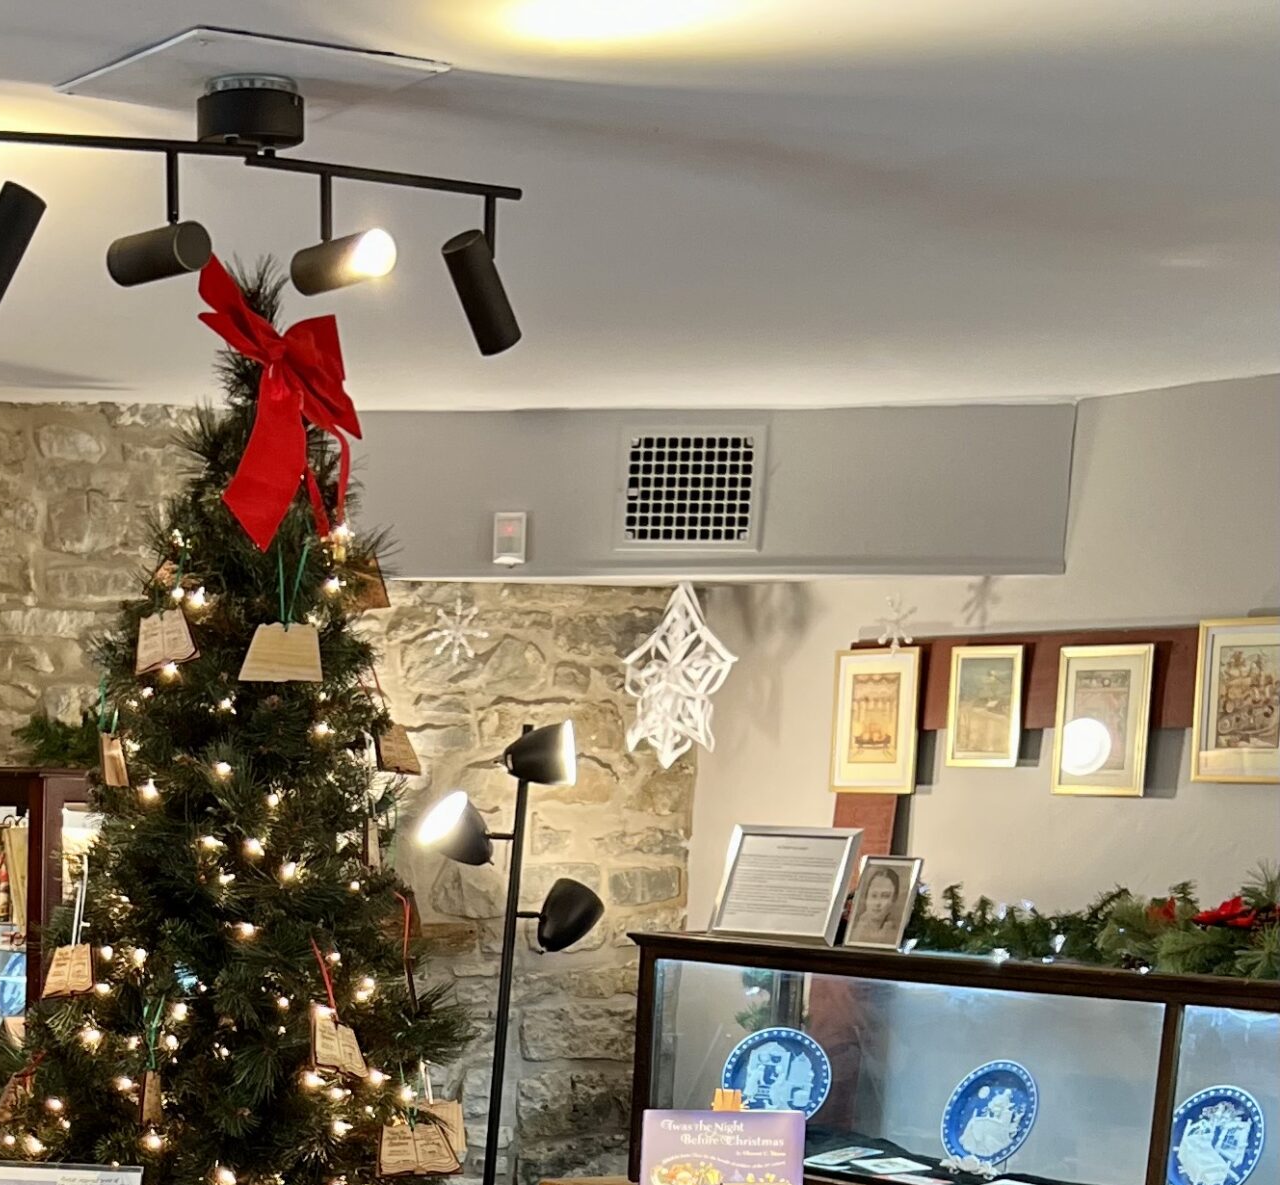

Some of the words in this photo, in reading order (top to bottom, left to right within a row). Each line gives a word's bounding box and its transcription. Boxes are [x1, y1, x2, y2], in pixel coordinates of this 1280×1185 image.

[713, 1120, 745, 1137] Night
[680, 1133, 719, 1146] Before
[720, 1133, 785, 1147] Christmas
